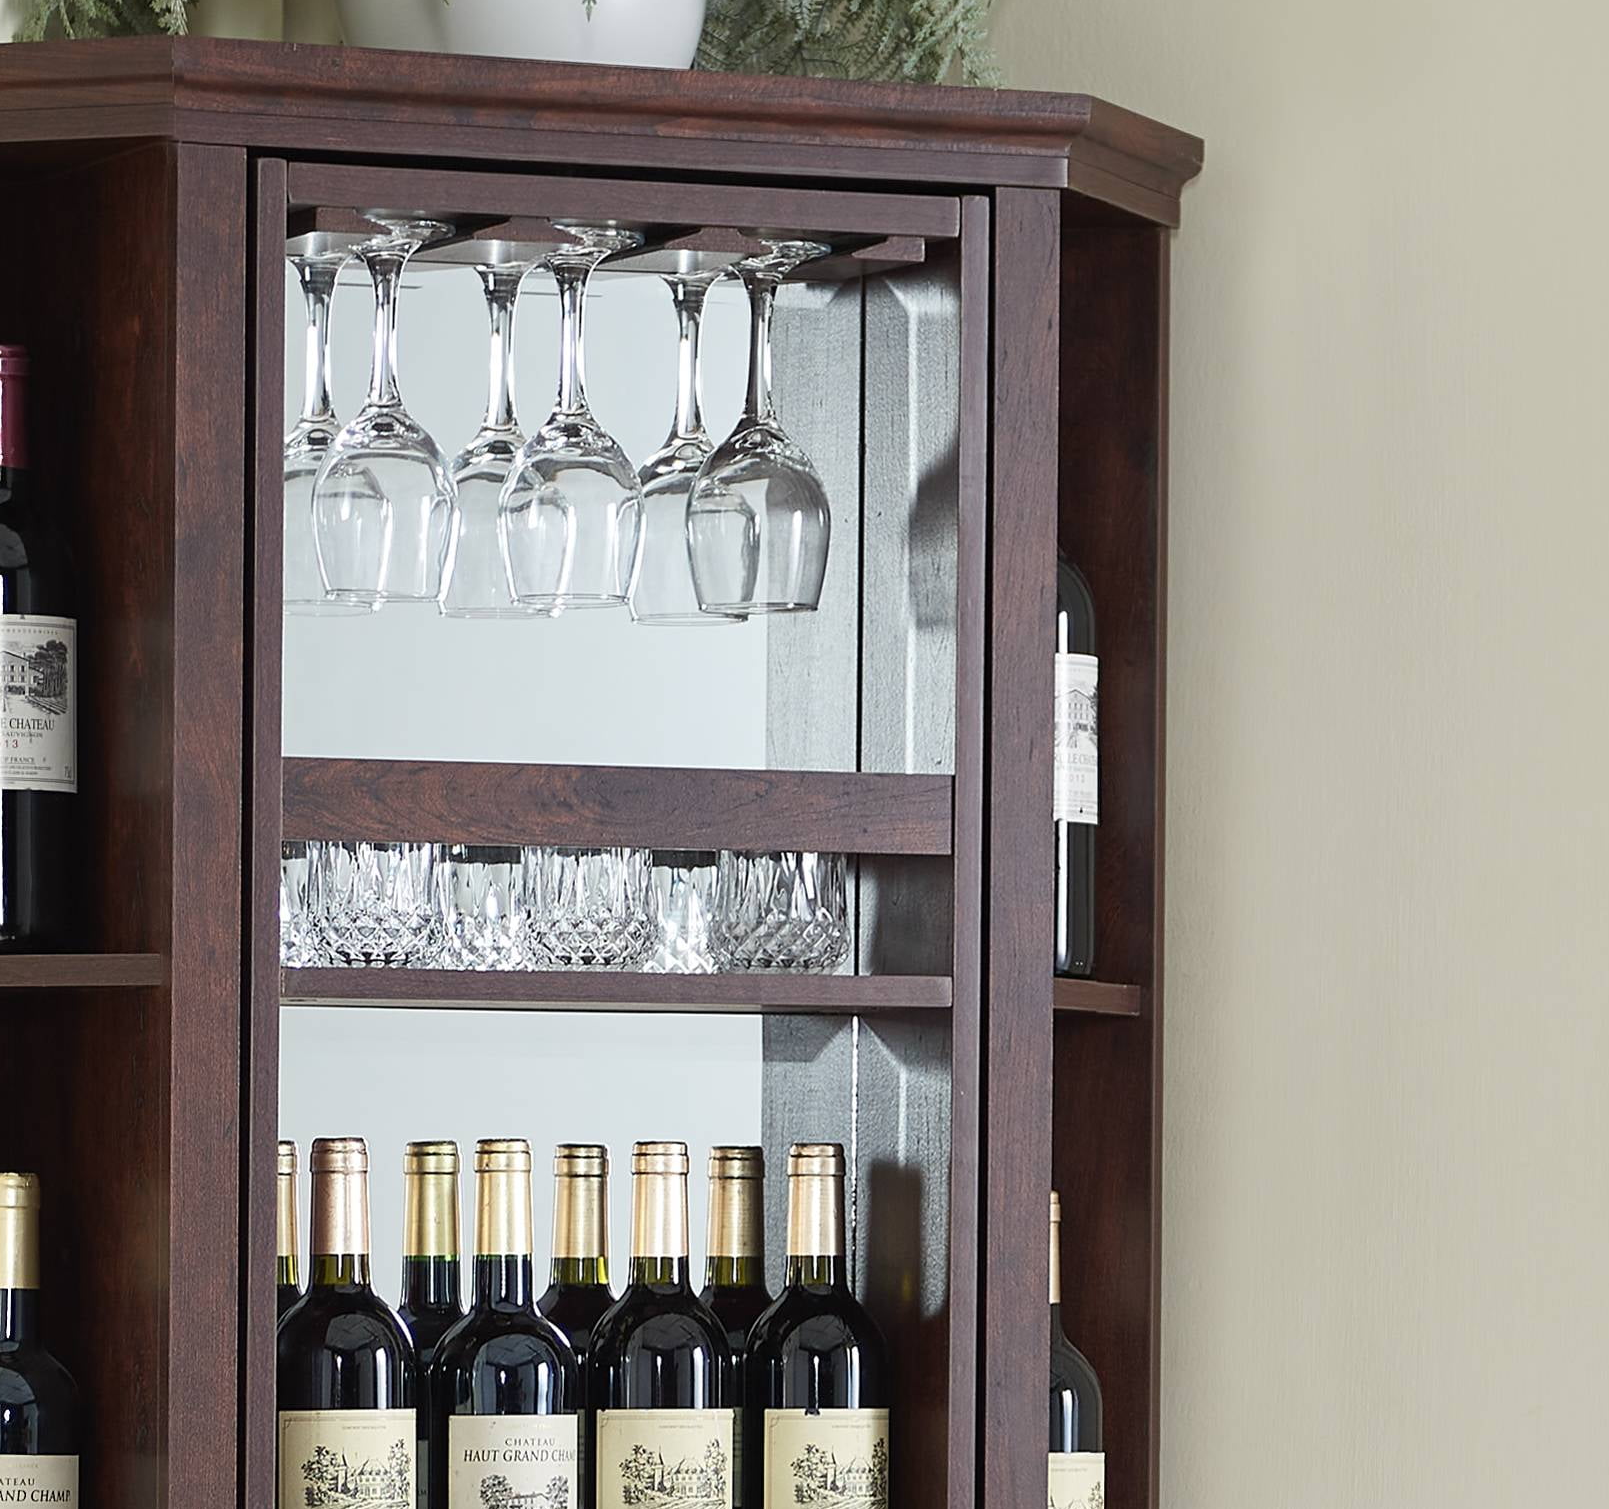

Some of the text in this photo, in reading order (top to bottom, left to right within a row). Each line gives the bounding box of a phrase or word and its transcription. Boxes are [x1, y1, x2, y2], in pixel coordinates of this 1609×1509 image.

[9, 718, 54, 731] CHATEAU
[504, 1437, 556, 1447] CHATEAU
[463, 1449, 499, 1462] HAUT
[503, 1449, 548, 1463] GRAND
